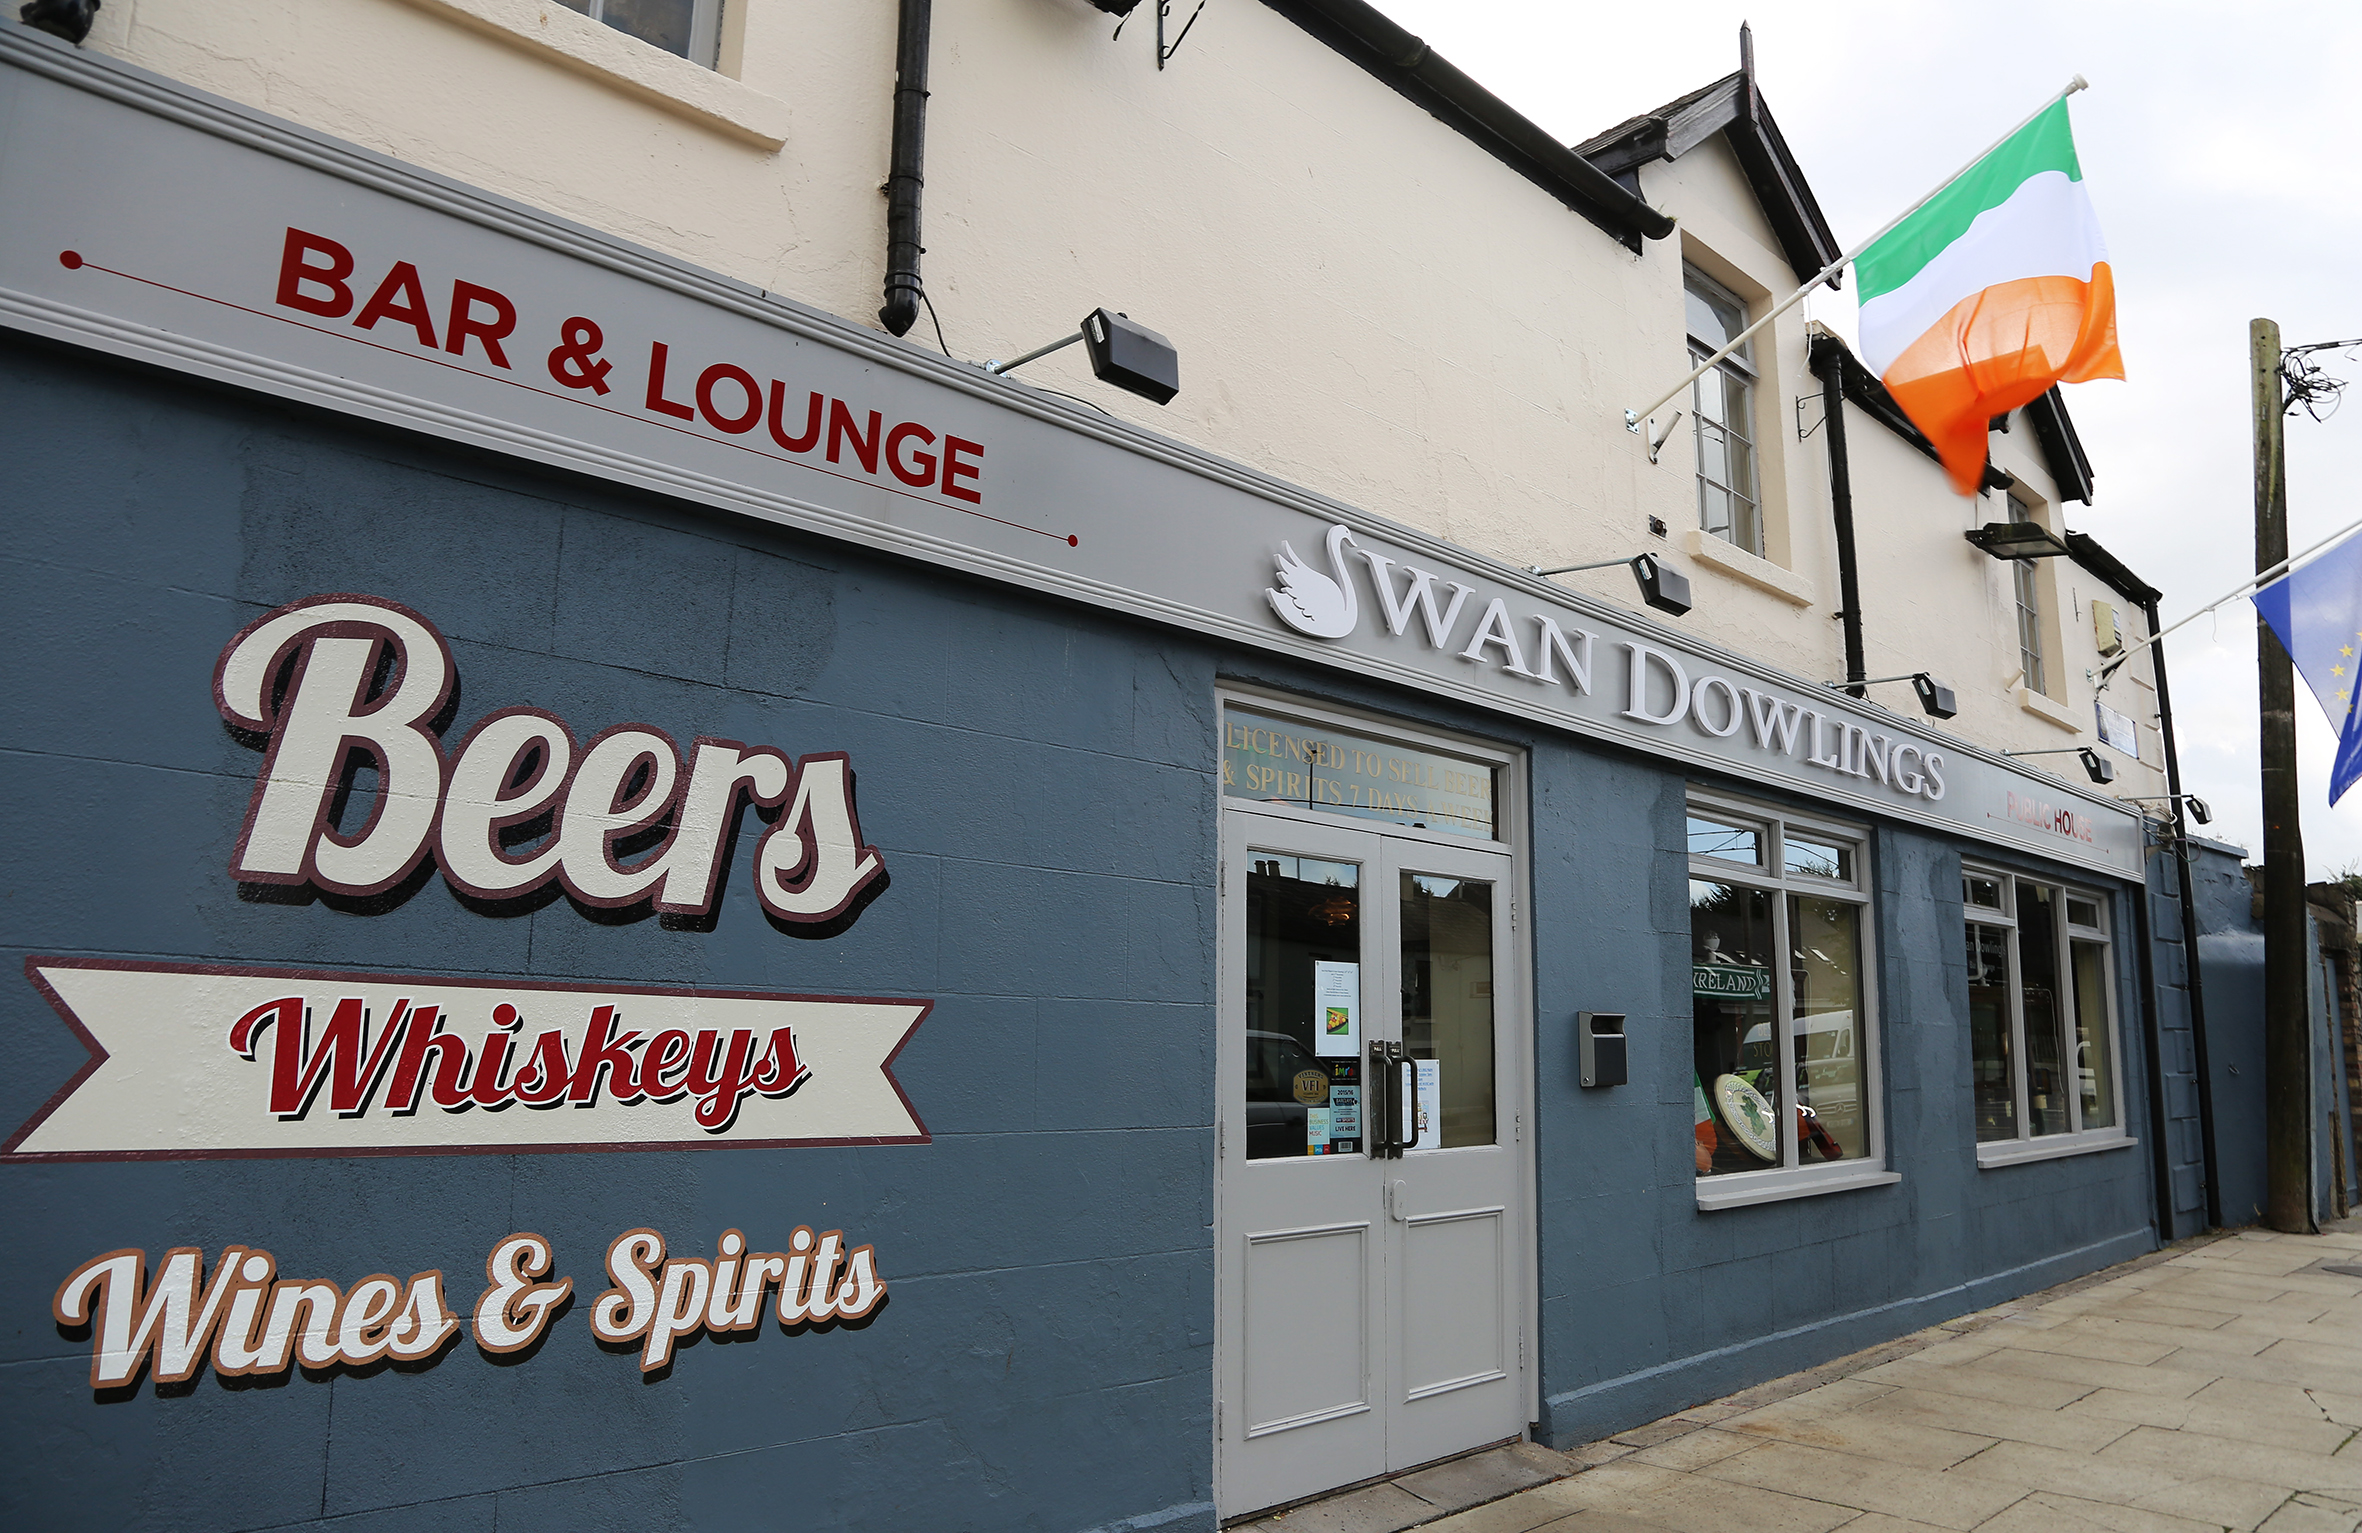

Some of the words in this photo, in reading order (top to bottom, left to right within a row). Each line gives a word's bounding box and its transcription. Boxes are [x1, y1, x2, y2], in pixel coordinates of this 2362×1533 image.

[275, 226, 518, 371] BAR
[547, 316, 613, 397] &
[645, 340, 985, 505] LOUNGE
[213, 592, 891, 938] Beers
[1224, 721, 1346, 771] LICENSED
[1352, 748, 1382, 778] TO
[1388, 757, 1440, 791] SELL
[1443, 769, 1493, 801] BEER
[1620, 639, 1947, 802] DOWLINGS
[1223, 759, 1236, 787] &
[1246, 763, 1343, 806] SPIRITS
[1350, 784, 1360, 808] 7
[1368, 787, 1419, 820] DAYS
[1425, 802, 1438, 823] A
[1441, 801, 1494, 833] WEEK
[2006, 790, 2052, 831] PUBLIC
[2054, 808, 2093, 843] HOUSE
[1693, 971, 1756, 992] IRELAND
[229, 994, 810, 1132] Whiskeys
[1301, 1080, 1319, 1091] VFI
[52, 1243, 460, 1403] Wines
[471, 1231, 576, 1367] &
[592, 1223, 888, 1381] Spirits
